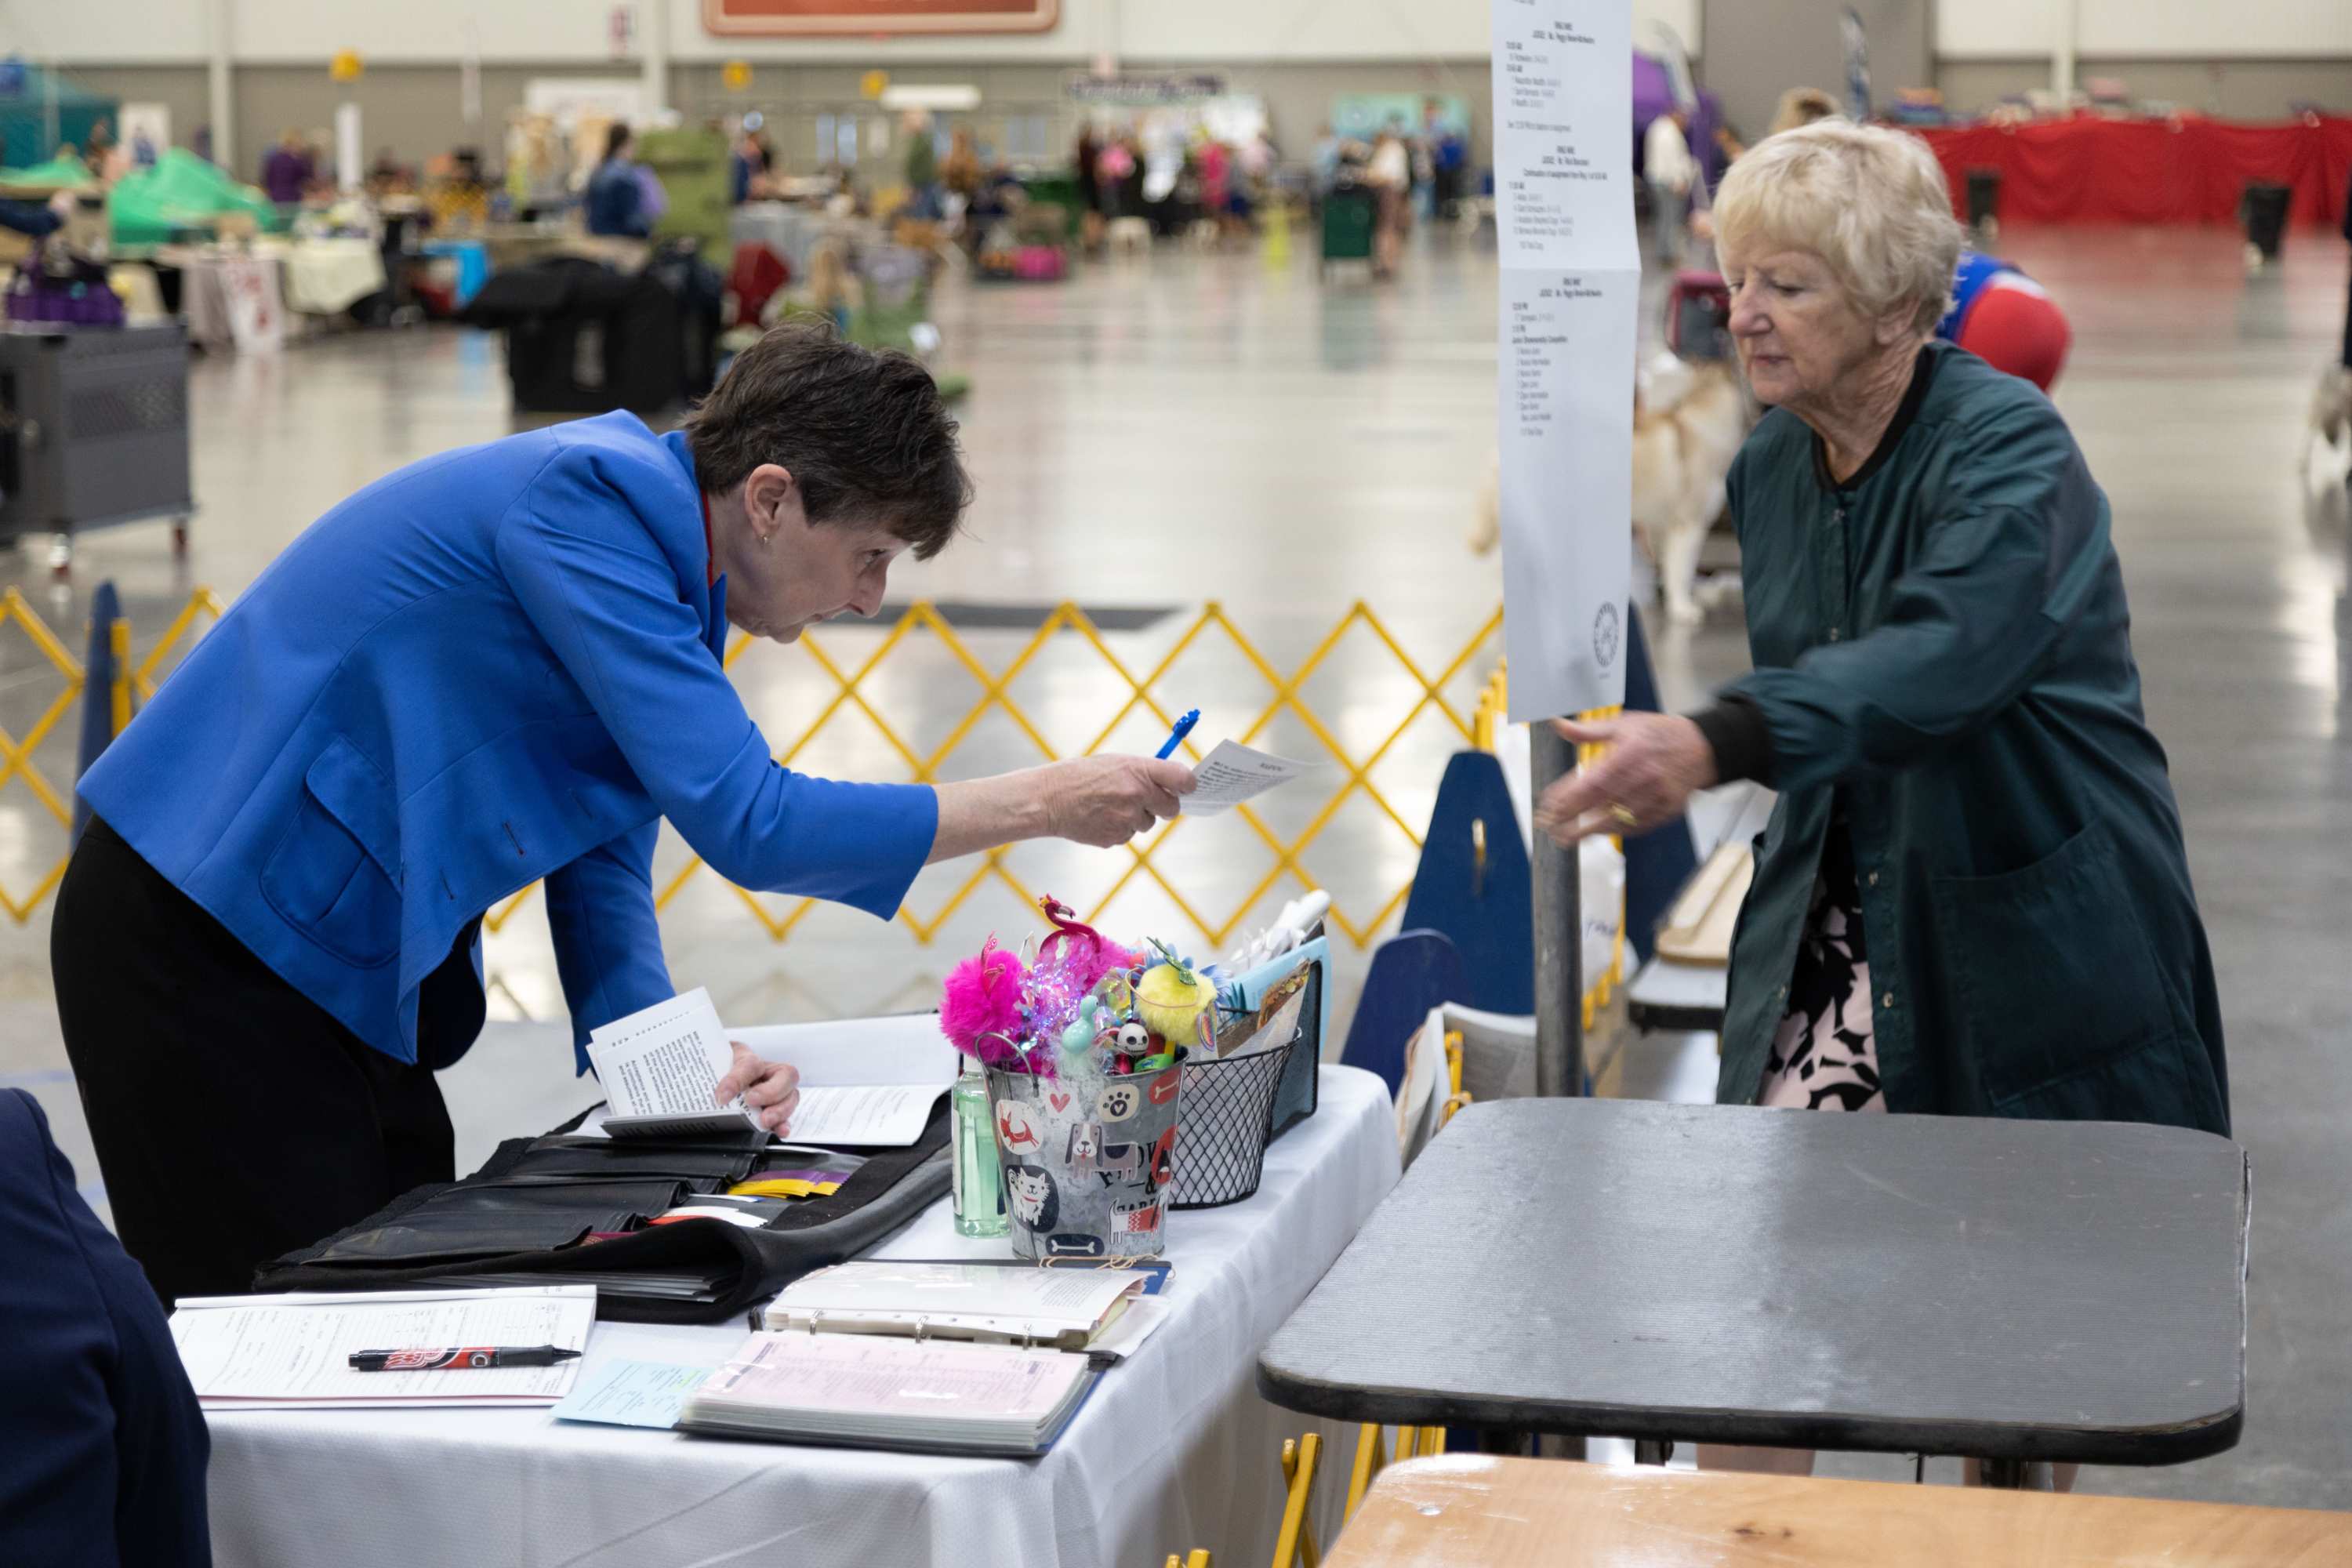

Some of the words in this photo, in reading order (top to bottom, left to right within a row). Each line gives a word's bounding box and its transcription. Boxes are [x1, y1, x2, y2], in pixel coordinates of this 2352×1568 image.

[666, 1043, 677, 1062] should
[630, 1059, 645, 1091] Acceptance
[655, 1067, 666, 1088] animals
[697, 1056, 709, 1076] against
[622, 1076, 633, 1100] assumes
[626, 1068, 641, 1097] conclusive
[652, 1076, 663, 1099] whatever
[655, 1048, 665, 1067] should
[662, 1067, 673, 1090] exercise
[671, 1091, 681, 1110] caution
[665, 1057, 677, 1080] exercise
[674, 1080, 685, 1101] caution
[685, 1073, 697, 1095] exercise
